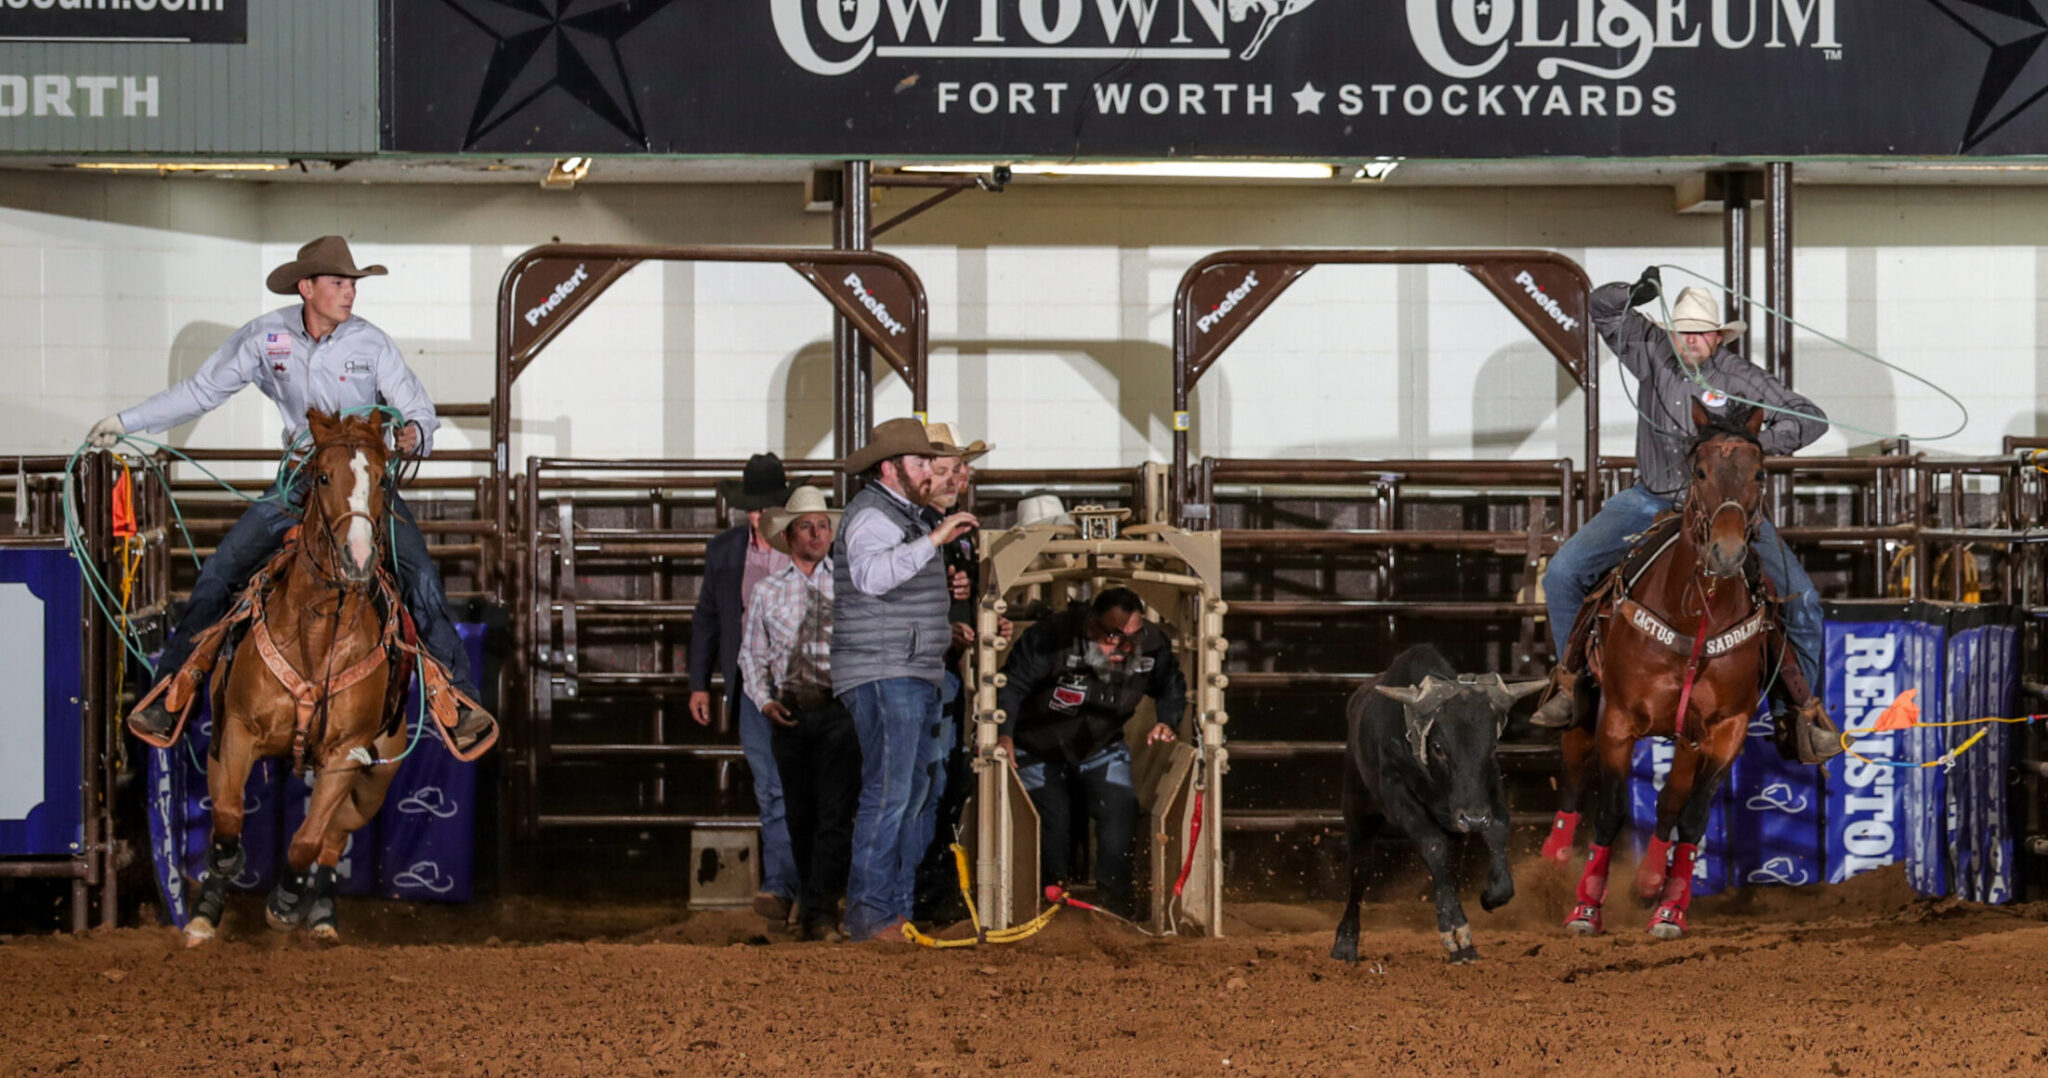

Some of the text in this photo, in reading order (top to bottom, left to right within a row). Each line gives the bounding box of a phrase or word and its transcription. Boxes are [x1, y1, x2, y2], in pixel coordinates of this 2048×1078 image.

[937, 82, 1678, 117] FORT WORTH STOCKYARDS
[524, 264, 588, 327] Priefert
[843, 272, 904, 336] Priefert
[1196, 272, 1259, 333] Priefert
[1515, 270, 1577, 331] Priefert
[1633, 609, 1676, 646] CACTUS
